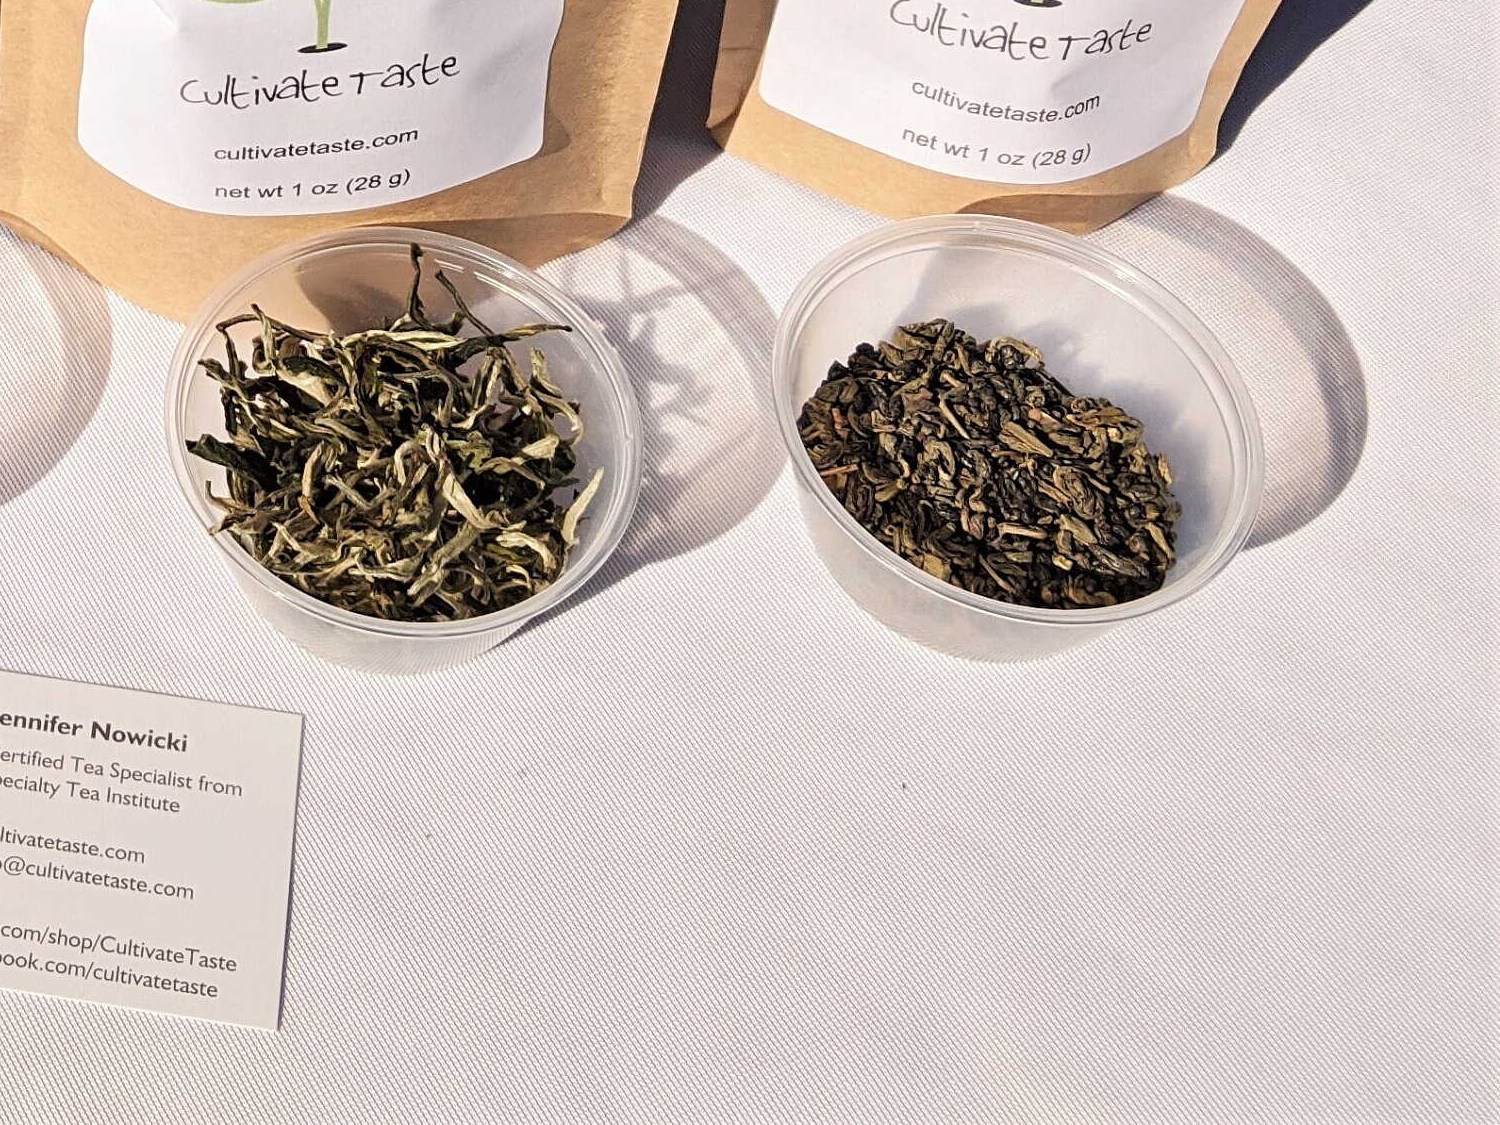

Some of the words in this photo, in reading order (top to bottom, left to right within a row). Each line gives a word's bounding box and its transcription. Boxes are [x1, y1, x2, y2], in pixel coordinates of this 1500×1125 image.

[1058, 19, 1152, 60] Taste
[180, 70, 342, 109] Cultivate
[349, 54, 460, 94] Taste
[912, 82, 1100, 122] cultivatetaste.com
[215, 130, 418, 160] cultivatetaste.com
[902, 128, 938, 151] net
[943, 142, 971, 159] wt
[978, 147, 989, 162] 1
[996, 153, 1026, 166] oz
[1031, 149, 1067, 171] (28
[1070, 142, 1092, 166] g)
[214, 186, 251, 199] net
[257, 184, 284, 199] wt
[291, 182, 302, 197] 1
[311, 183, 339, 196] oz
[345, 174, 382, 196] (28
[388, 168, 411, 189] g)
[91, 721, 187, 752] Nowicki
[65, 780, 100, 802] Tea
[107, 787, 180, 812] Institute
[70, 755, 105, 777] Tea
[110, 762, 192, 789] Specialist
[198, 775, 243, 797] from
